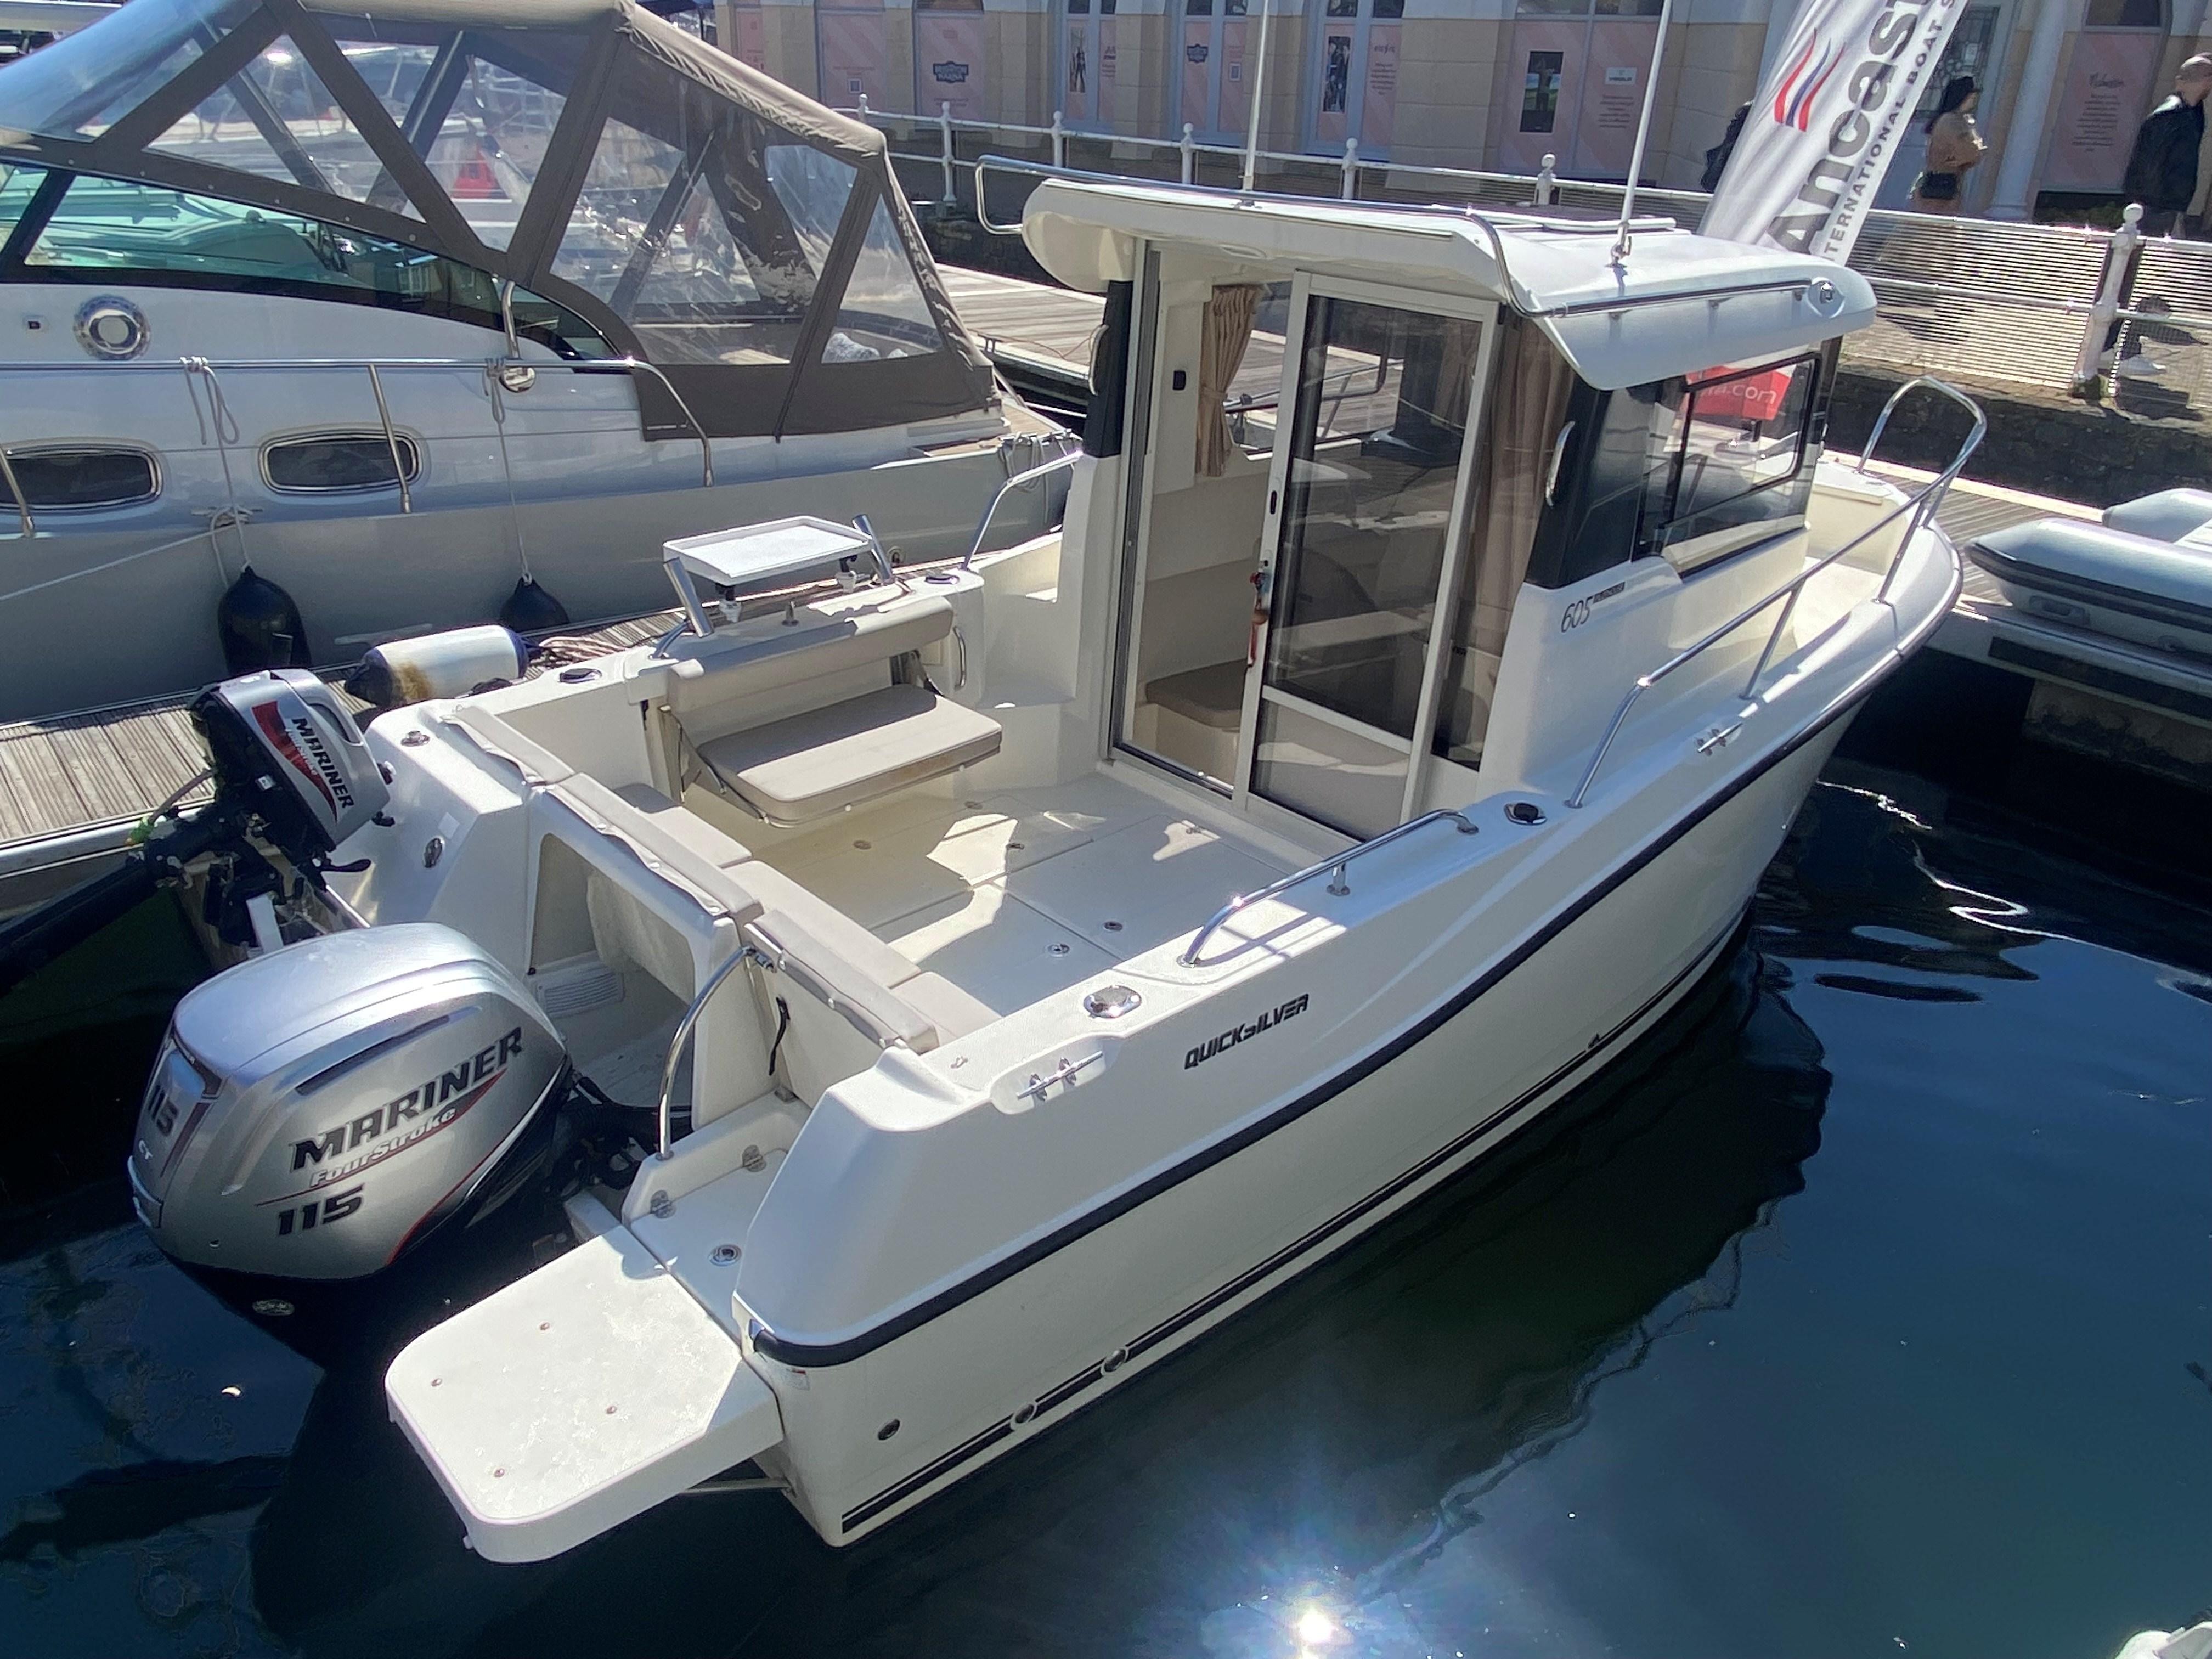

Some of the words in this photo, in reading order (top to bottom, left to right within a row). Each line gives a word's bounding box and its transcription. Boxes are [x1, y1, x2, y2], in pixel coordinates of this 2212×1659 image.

[1764, 0, 1929, 255] Ancas
[1821, 97, 1905, 261] TERNATIONAL
[1906, 19, 1942, 85] BOAT
[1561, 596, 1594, 633] 605
[291, 717, 354, 809] MARINER
[1184, 993, 1309, 1069] QUICKSILVER
[148, 1085, 179, 1137] 115
[291, 1026, 523, 1171] MARINER
[311, 1107, 456, 1187] FourStroke
[278, 1184, 364, 1235] 115
